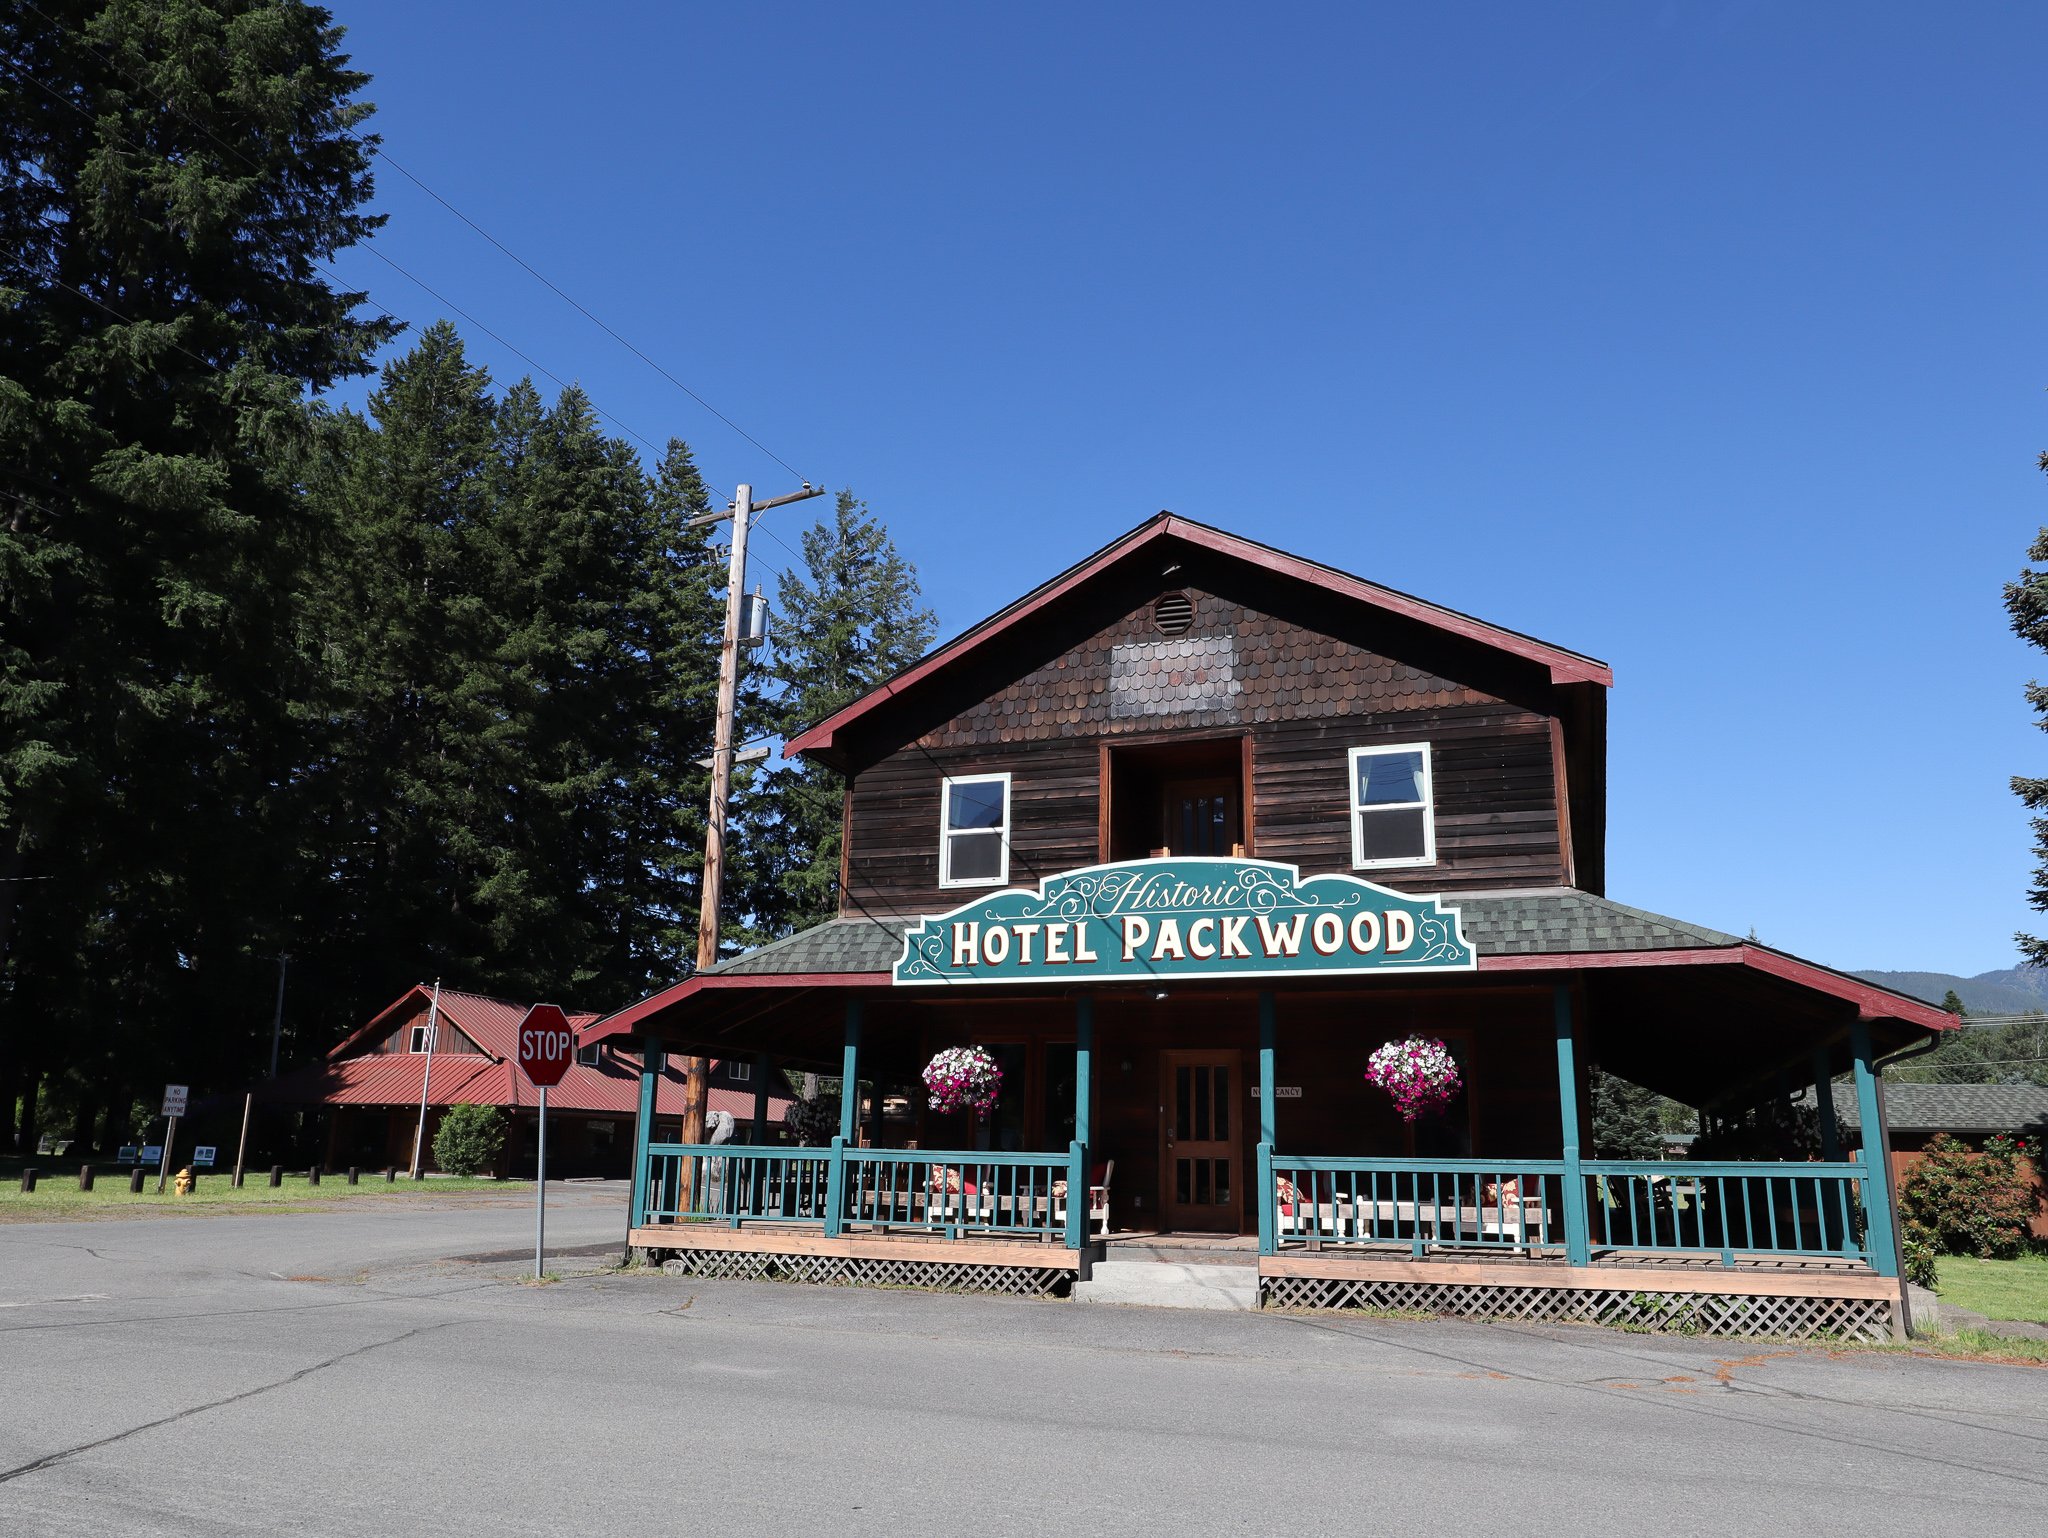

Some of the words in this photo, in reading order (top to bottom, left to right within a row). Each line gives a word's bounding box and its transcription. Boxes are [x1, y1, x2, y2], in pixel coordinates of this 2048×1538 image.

[1092, 871, 1245, 919] Historic
[950, 921, 1098, 967] HOTEL
[1120, 910, 1415, 962] PACKWOOD
[522, 1030, 570, 1061] STOP
